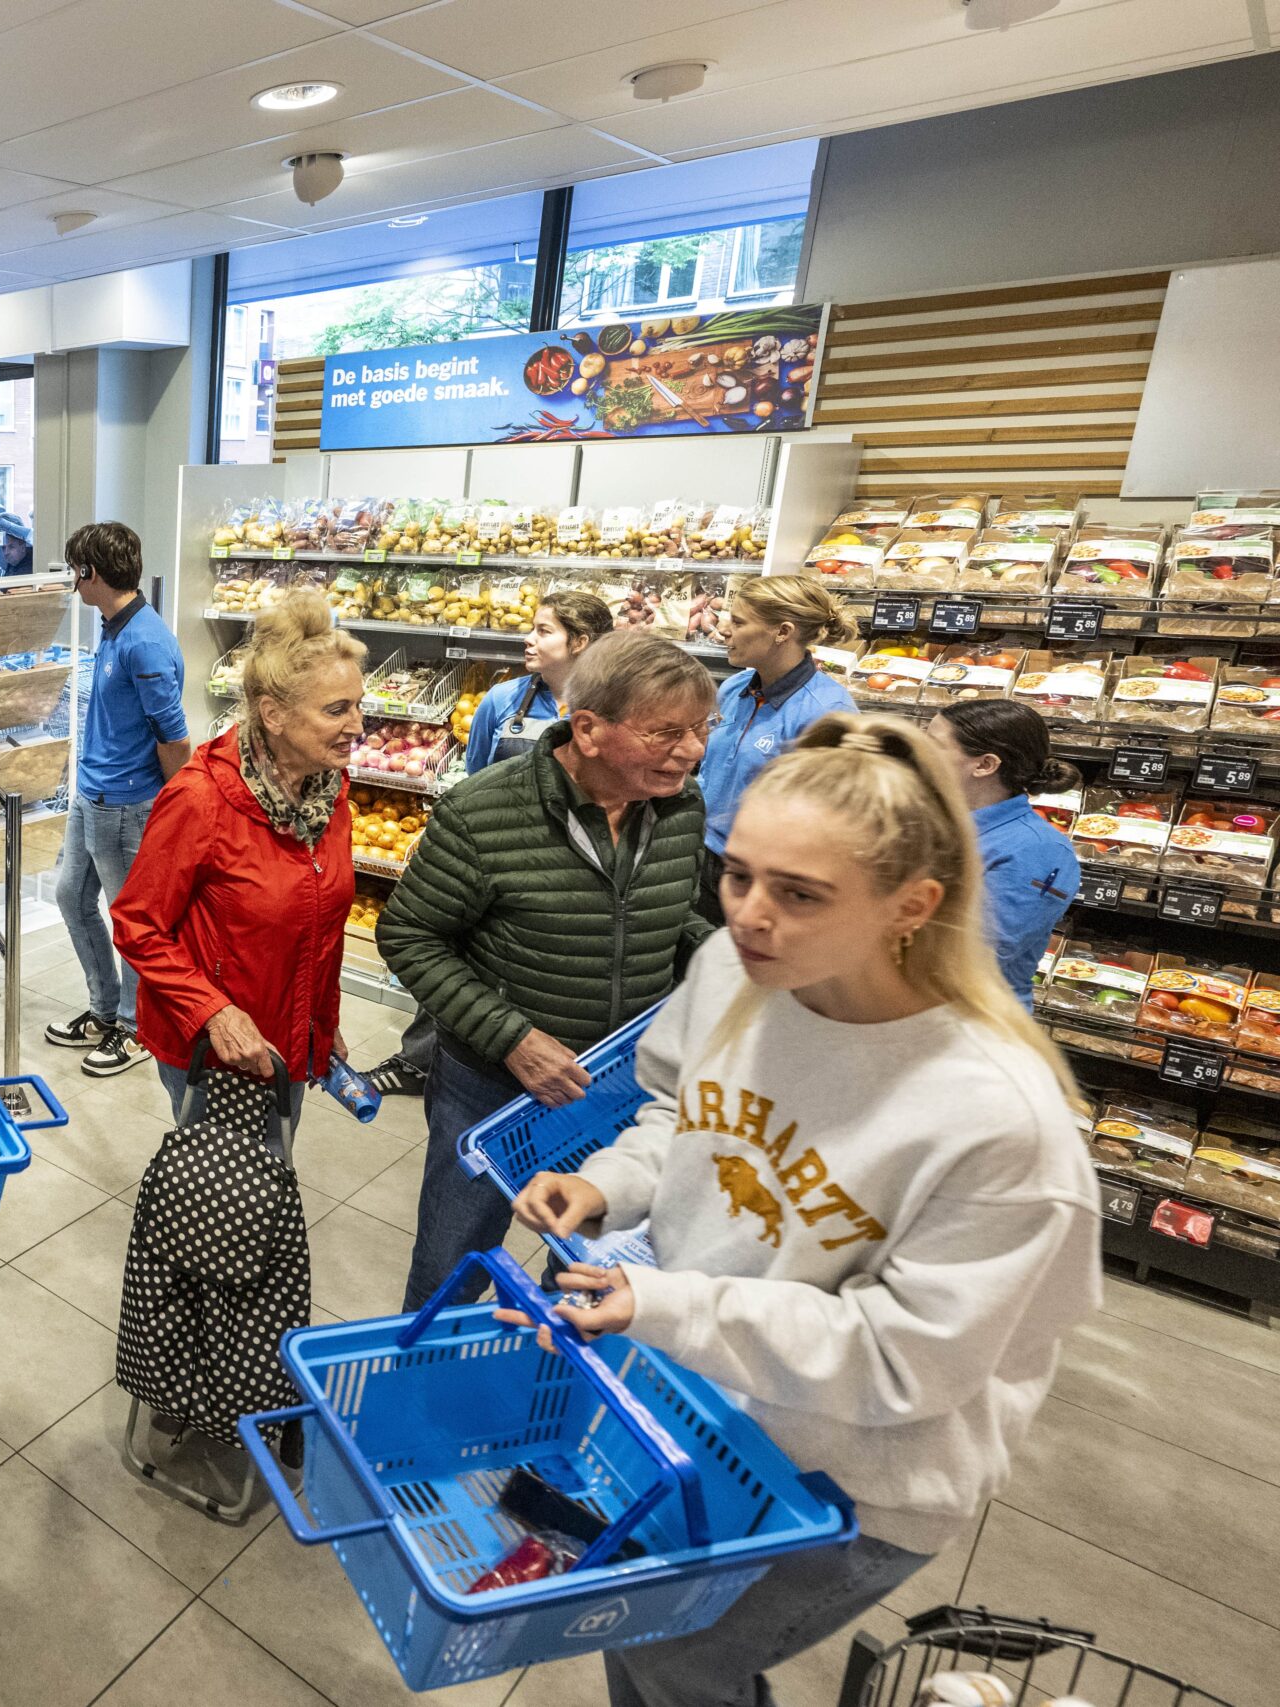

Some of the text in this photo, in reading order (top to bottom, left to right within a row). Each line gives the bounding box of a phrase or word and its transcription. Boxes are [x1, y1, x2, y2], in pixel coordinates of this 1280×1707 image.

[332, 356, 480, 386] De basis begint
[331, 376, 510, 410] met goede smaak.
[895, 610, 915, 624] 5.89
[955, 613, 975, 627] 5.89
[1074, 618, 1096, 633] 5.89
[1140, 761, 1164, 776] 5.89
[1225, 770, 1251, 785] 5.89
[1094, 887, 1118, 901] 5.89
[1191, 903, 1216, 917] 5.89
[1192, 1065, 1218, 1080] 5.89
[1108, 1197, 1134, 1213] 4.79
